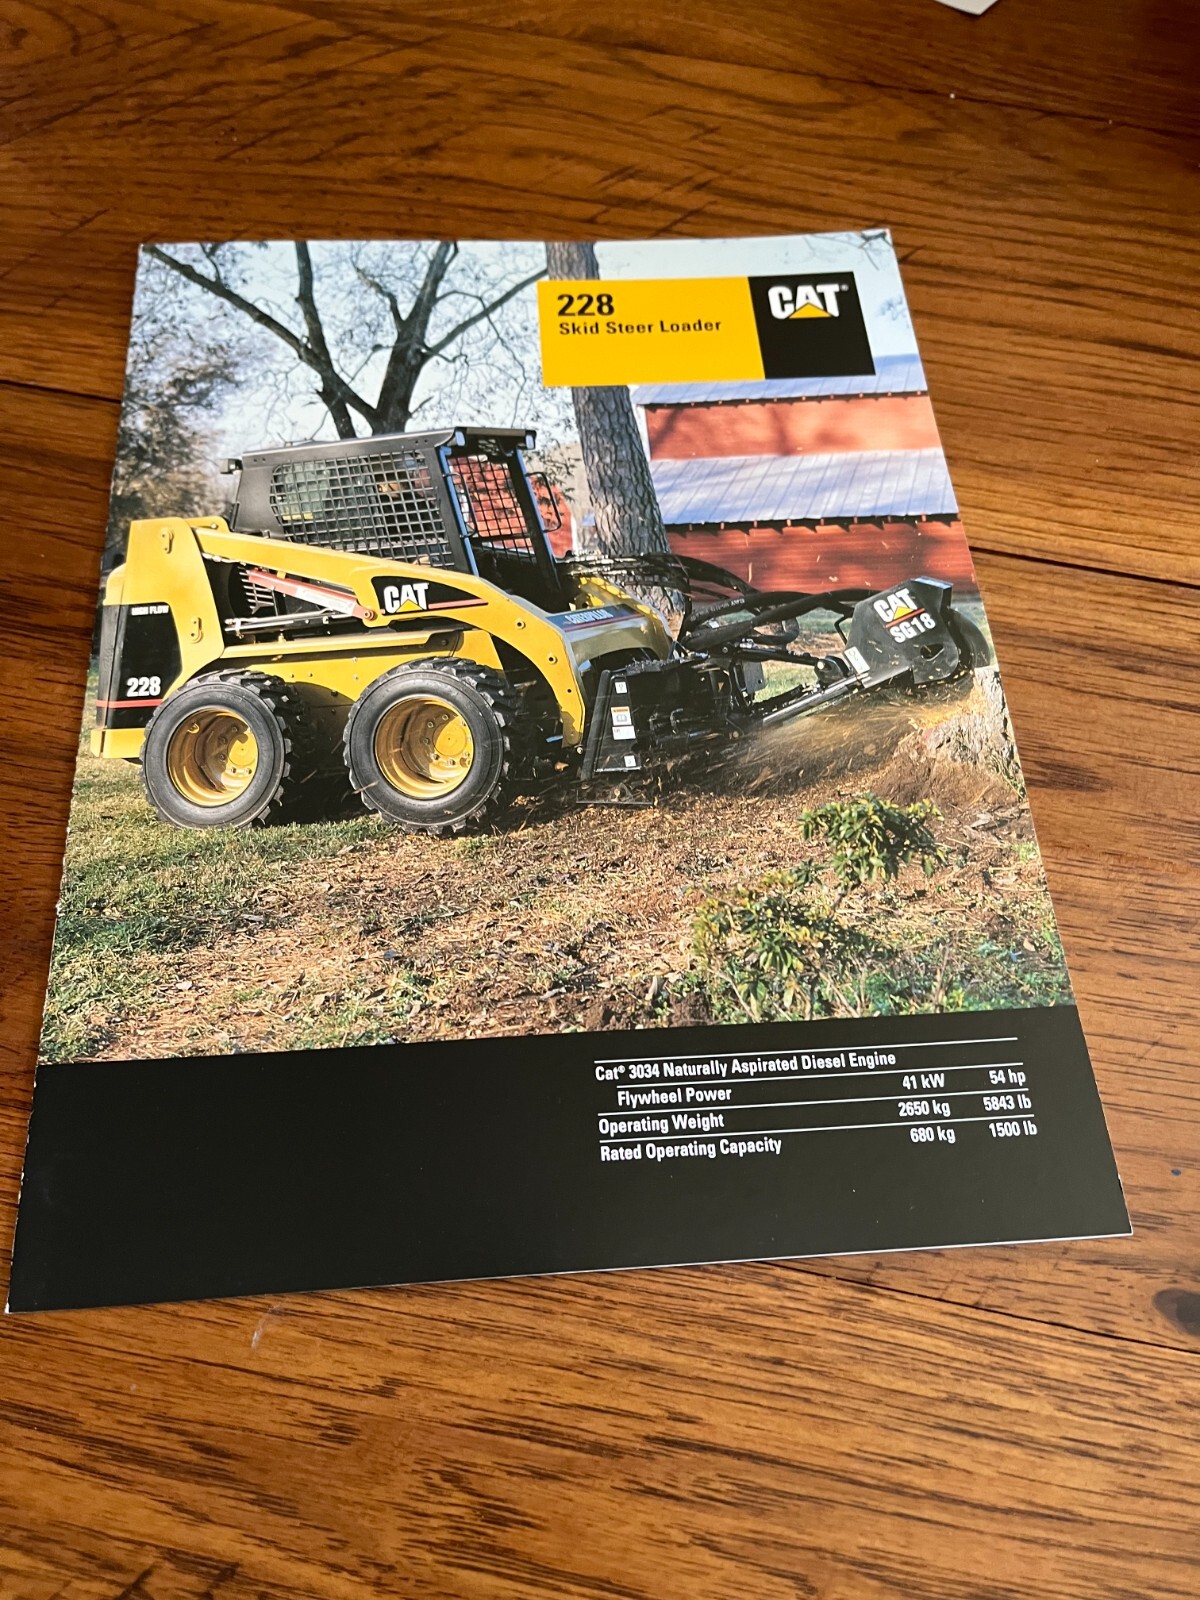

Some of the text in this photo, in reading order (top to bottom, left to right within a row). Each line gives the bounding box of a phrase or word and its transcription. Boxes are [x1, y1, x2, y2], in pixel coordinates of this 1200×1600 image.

[557, 294, 615, 316] 228
[559, 318, 722, 335] Skid Steer Loader
[383, 583, 429, 614] CAT
[873, 588, 918, 623] CAT
[889, 612, 936, 644] SG18
[126, 676, 161, 697] 228
[628, 1063, 661, 1080] 3034
[662, 1059, 727, 1078] Naturally
[731, 1055, 798, 1077] Aspirated
[801, 1053, 845, 1070] Diesel
[849, 1051, 896, 1069] Engine
[617, 1068, 1026, 1108] Flywheel Power 41 kW 54 hp
[599, 1093, 1032, 1137] Operating Weight 2650 kg 5843 lb
[600, 1120, 1038, 1162] Rated Operating Capacity 680 kg 1500 lb
